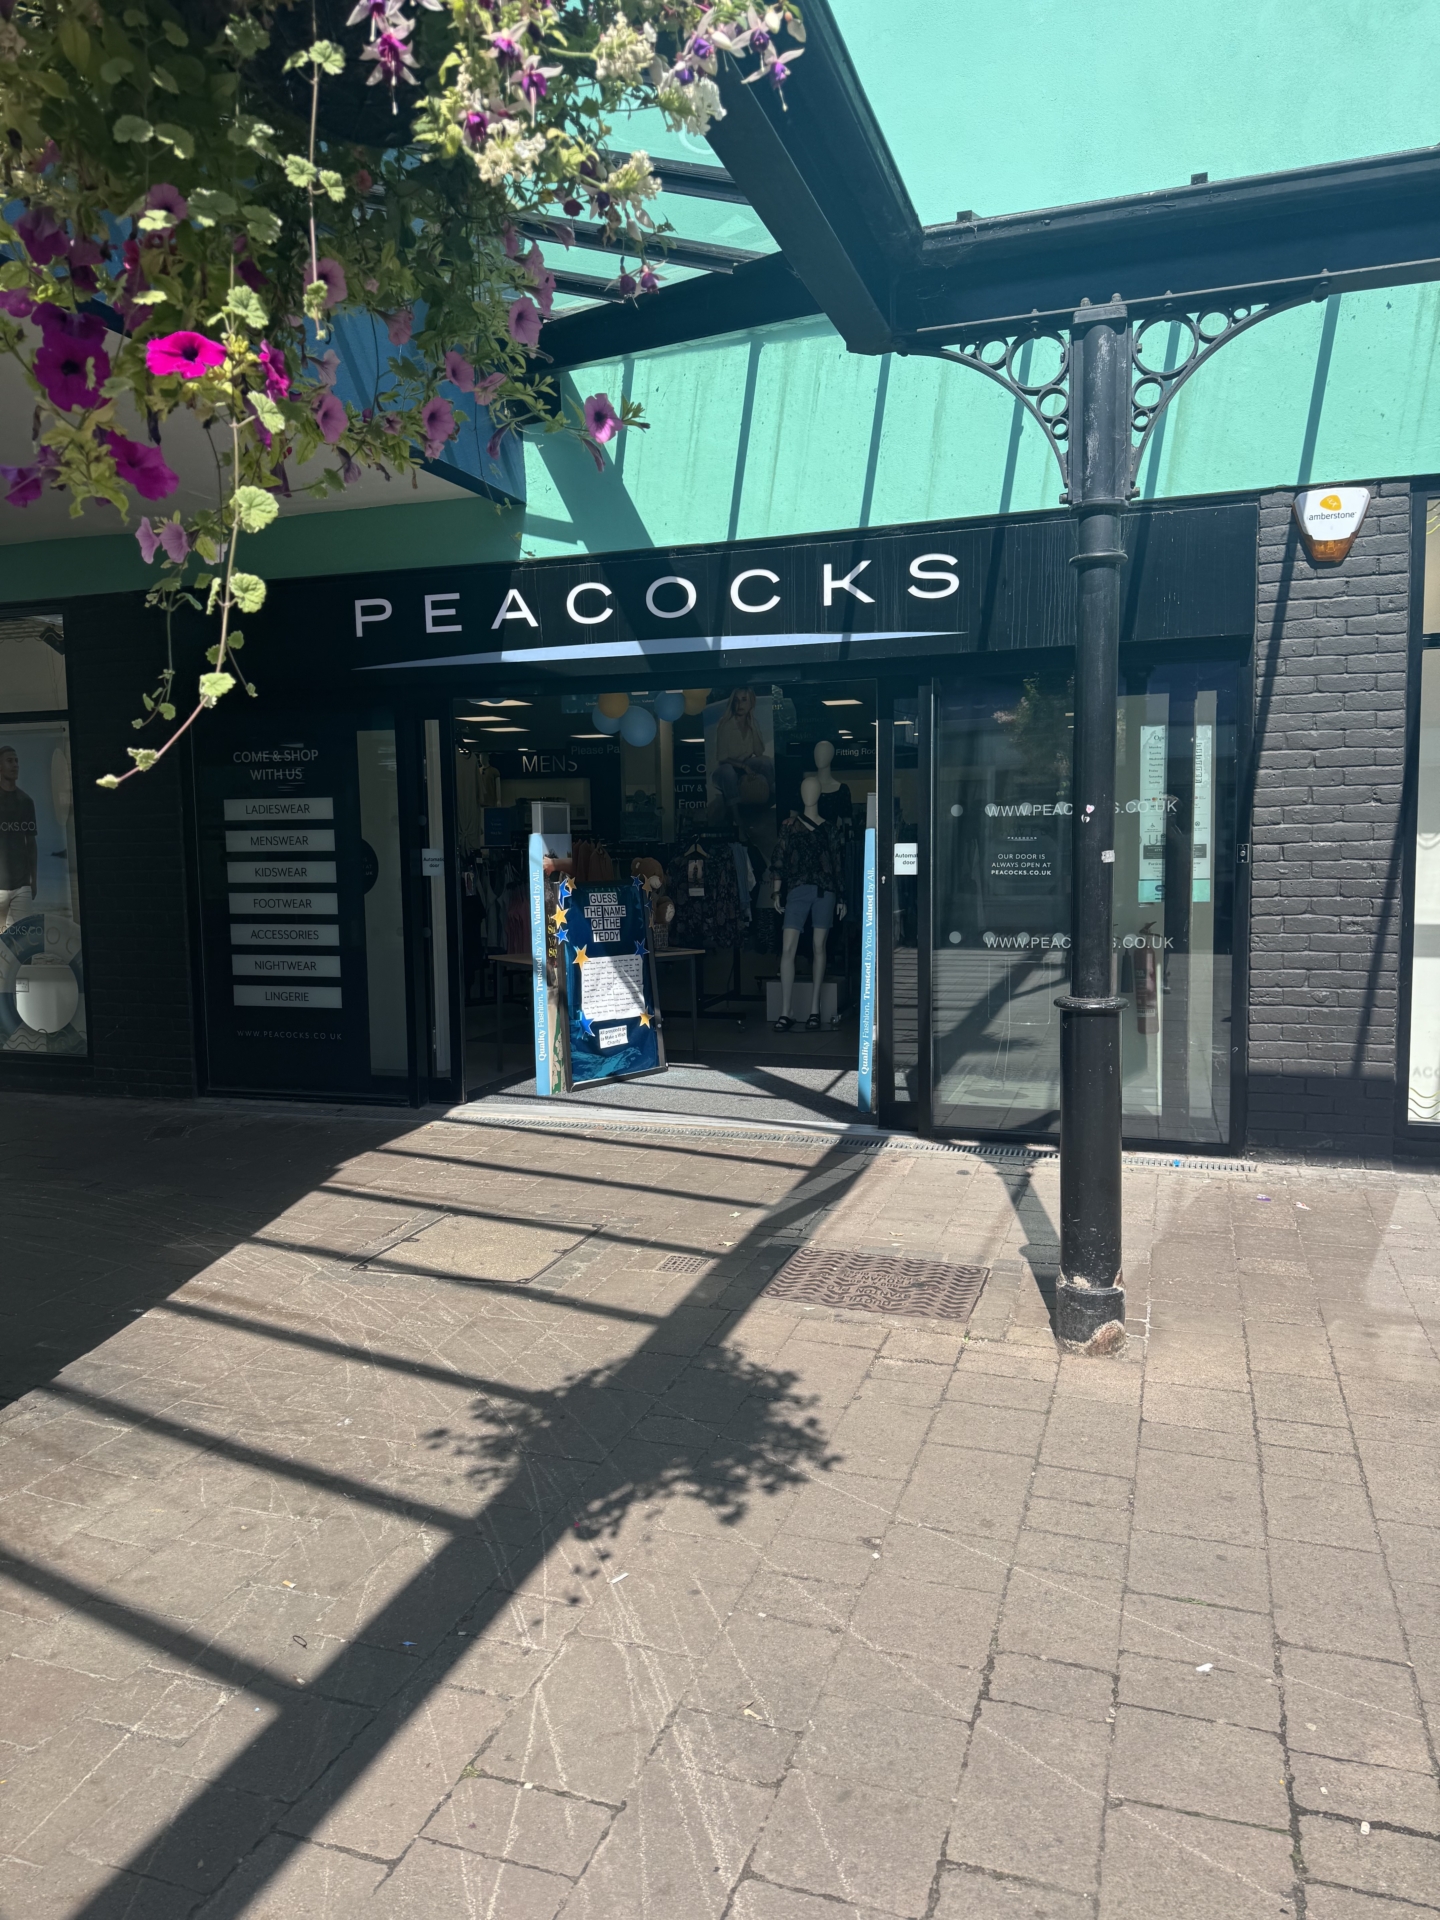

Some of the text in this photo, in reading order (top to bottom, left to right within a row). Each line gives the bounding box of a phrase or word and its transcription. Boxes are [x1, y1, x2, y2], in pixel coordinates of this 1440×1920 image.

[1308, 511, 1355, 521] amberstone
[354, 552, 961, 638] PEACOCKS
[570, 744, 620, 755] Please Pa
[835, 748, 860, 757] Fitting
[232, 749, 319, 763] COME & SHOP
[522, 755, 579, 773] MENS
[250, 768, 303, 781] WITH US
[245, 804, 311, 815] LADIESWEAR
[250, 836, 309, 846] MENSWEAR
[254, 867, 308, 878] KIDSWEAR
[533, 884, 541, 893] by
[867, 883, 875, 893] by
[253, 898, 312, 909] FOOTWEAR
[590, 893, 618, 904] GUESS
[533, 895, 541, 925] Valued
[584, 906, 625, 917] THE NAME
[866, 894, 874, 927] Valued
[591, 918, 620, 929] OF THE
[250, 929, 319, 940] ACCESSORIES
[534, 927, 542, 945] You.
[594, 931, 620, 941] TEDDY
[865, 929, 873, 949] You.
[535, 946, 543, 956] by
[865, 950, 873, 960] by
[254, 960, 317, 971] NIGHTWEAR
[535, 957, 544, 992] Trusted
[864, 962, 872, 1000] Trusted
[264, 991, 309, 1001] LINGERIE
[536, 993, 545, 1028] Fashion.
[862, 1002, 870, 1038] Fashion.
[538, 1029, 547, 1061] Quality
[861, 1040, 870, 1075] Quality
[861, 1275, 912, 1285] TROJAN
[856, 1287, 912, 1299] STANTON
